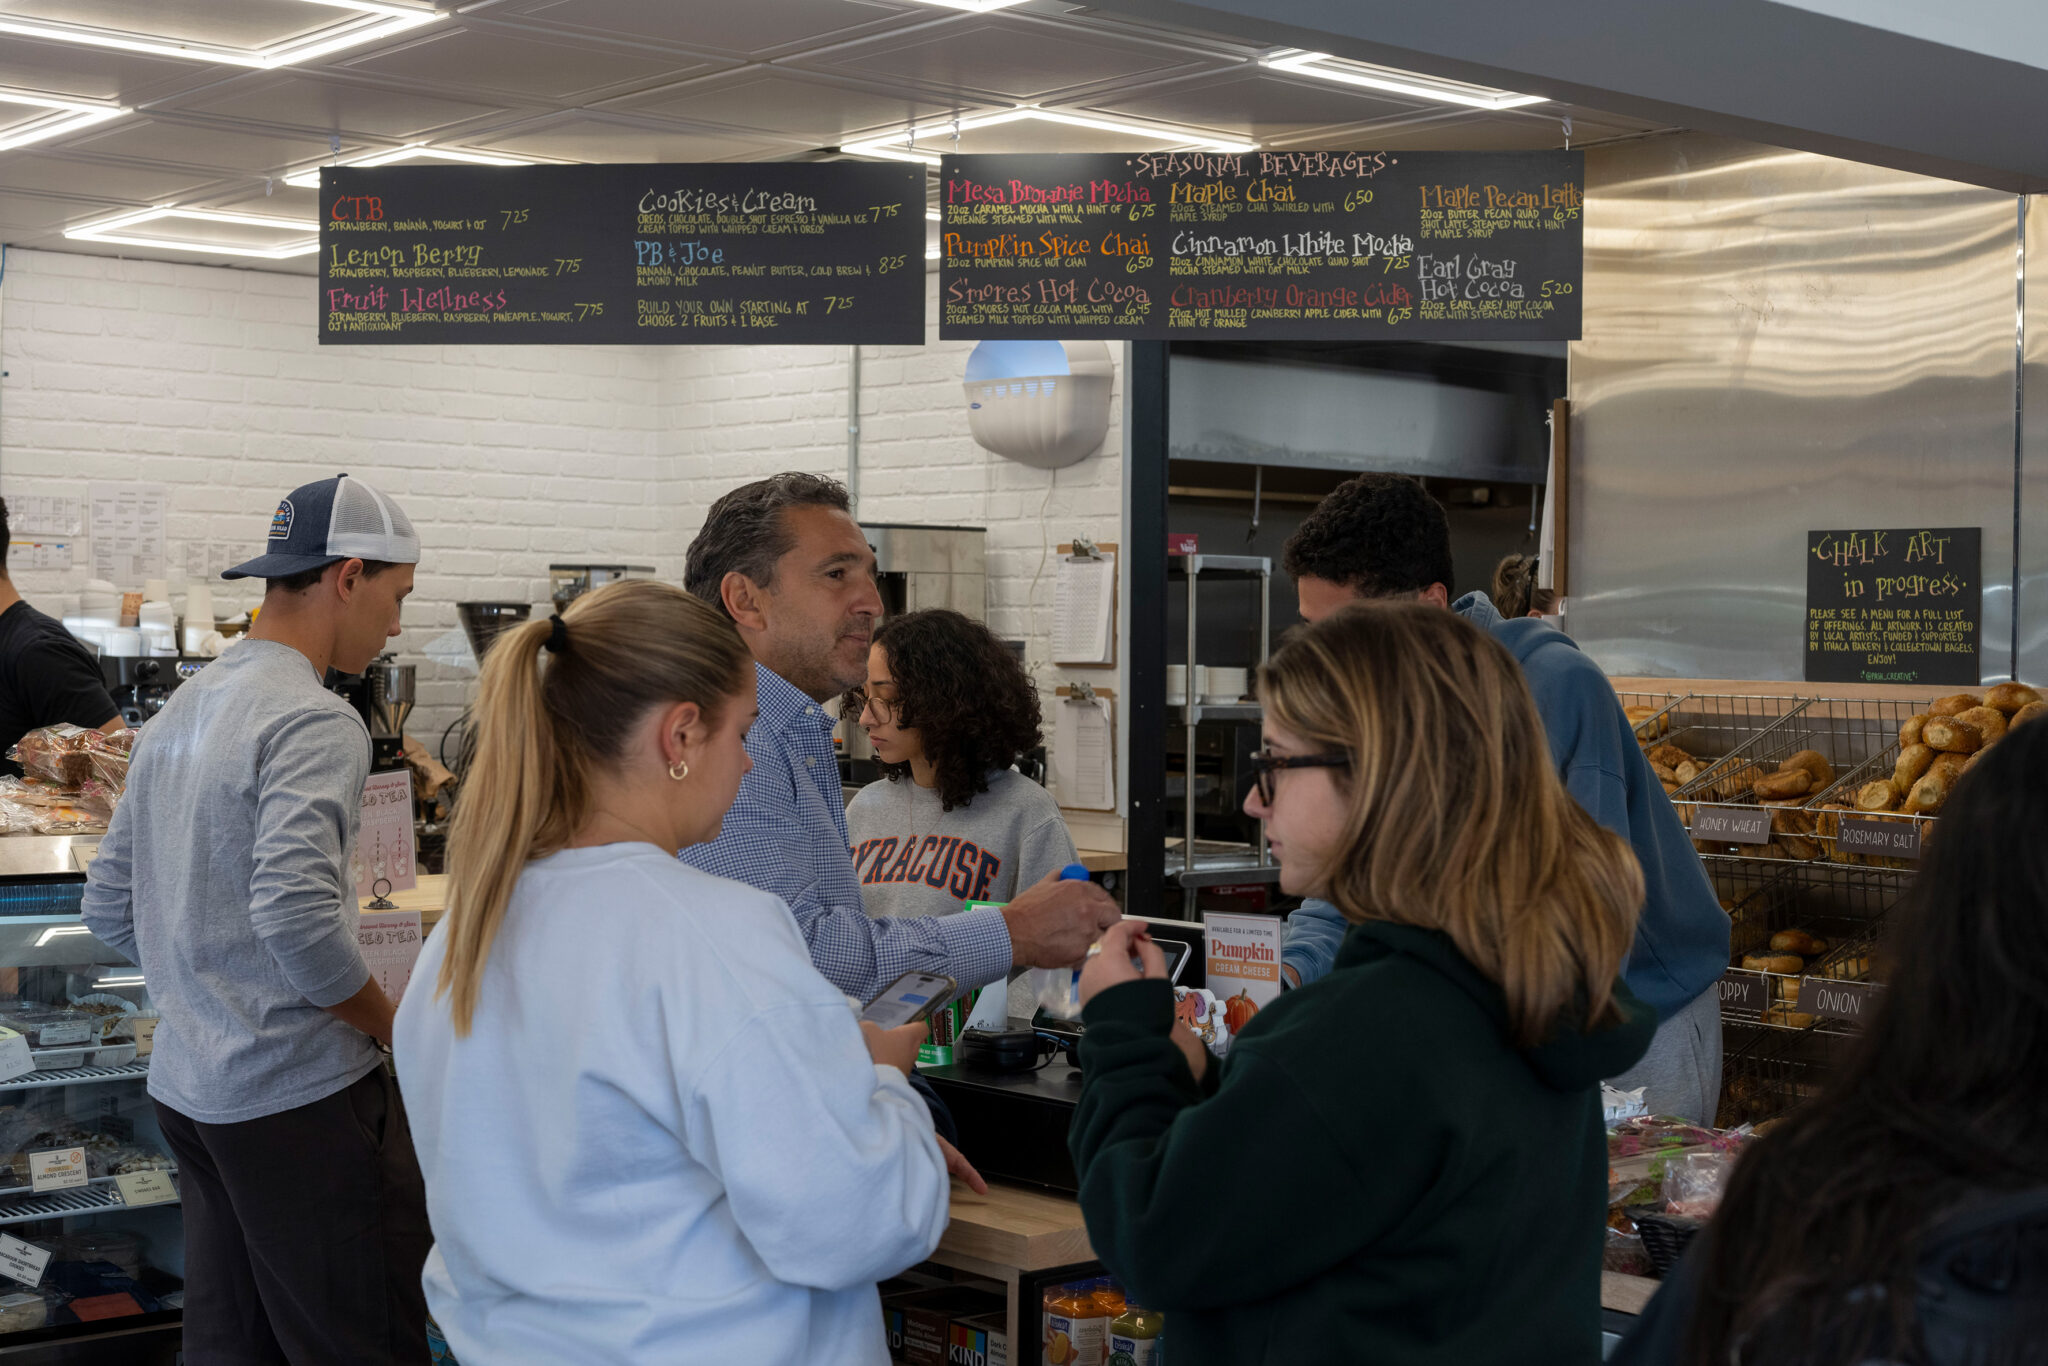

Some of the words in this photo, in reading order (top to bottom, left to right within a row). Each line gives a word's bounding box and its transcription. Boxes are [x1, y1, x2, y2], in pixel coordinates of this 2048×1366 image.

[1135, 152, 1249, 178] SEASONAL
[1260, 151, 1387, 178] BEVERAGES
[638, 189, 729, 214] Cookies
[732, 194, 739, 211] &
[742, 188, 817, 214] Cream
[947, 179, 1006, 204] Mesa
[1009, 179, 1084, 204] Brownie
[1089, 180, 1150, 203] Mocha
[1169, 180, 1237, 205] Maple
[1246, 178, 1296, 202] Chai
[1419, 184, 1480, 209] Maple
[1484, 185, 1539, 209] Pecan
[1542, 182, 1584, 209] Latte
[332, 195, 383, 221] CTB
[1170, 213, 1197, 222] MAPLE
[1202, 213, 1228, 222] SYRUP
[1172, 230, 1277, 256] Cinnamon
[1283, 230, 1345, 257] White
[1352, 232, 1413, 257] Mocha
[1421, 230, 1430, 238] OF
[1435, 230, 1463, 238] MAPLE
[1467, 229, 1493, 238] SYRUP
[634, 240, 663, 265] PB
[668, 243, 677, 263] &
[680, 240, 724, 265] Joe
[944, 233, 1034, 257] Pumpkin
[1039, 230, 1091, 259] Spice
[1101, 231, 1150, 257] Chai
[330, 243, 403, 267] Lemon
[414, 243, 483, 267] Berry
[1417, 253, 1461, 280] Earl
[1466, 253, 1517, 280] Gray
[637, 276, 670, 286] ALMOND
[675, 276, 698, 286] MILK
[947, 278, 1031, 304] S'mores
[1038, 279, 1079, 304] Hot
[1088, 278, 1150, 303] Cocoa
[1421, 280, 1458, 300] Hot
[1465, 280, 1525, 299] Cocoa
[327, 284, 388, 312] Fruit
[400, 287, 507, 312] Wellness
[1171, 282, 1277, 308] Cranberry
[1286, 284, 1358, 309] Orange
[1364, 282, 1413, 307] Cider
[638, 300, 669, 314] BUILD
[676, 300, 702, 314] YOUR
[710, 301, 733, 313] OWN
[740, 301, 791, 314] STARTING
[796, 302, 810, 314] AT
[1420, 310, 1446, 319] MADE
[1446, 310, 1468, 319] WITH
[1471, 310, 1515, 319] STEAMED
[1519, 310, 1544, 319] MILK
[638, 315, 676, 326] CHOOSE
[680, 315, 688, 326] 2
[694, 315, 728, 327] FRUITS
[731, 316, 736, 326] &
[741, 315, 747, 327] 1
[751, 315, 778, 327] BASE
[946, 315, 984, 324] STEAMED
[989, 315, 1009, 324] MILK
[1011, 315, 1045, 324] TOPPED
[1049, 315, 1070, 324] WITH
[1074, 315, 1110, 324] WHIPPED
[1114, 315, 1144, 325] CREAM
[1169, 318, 1176, 327] A
[1178, 318, 1196, 327] HINT
[1200, 319, 1210, 327] OF
[1214, 319, 1247, 328] ORANGE
[1817, 531, 1889, 566] CHALK
[1904, 531, 1951, 564] ART
[1844, 572, 1864, 597] in
[1876, 571, 1959, 601] progress
[1810, 609, 1836, 619] PLEASE
[1841, 609, 1856, 619] SEE
[1861, 609, 1868, 619] A
[1870, 609, 1893, 619] MENU
[1897, 609, 1911, 619] FOR
[1914, 610, 1920, 619] A
[1923, 609, 1942, 619] FULL
[1945, 610, 1964, 619] LIST
[1810, 621, 1819, 630] OF
[1871, 621, 1883, 630] ALL
[1887, 622, 1920, 630] ARTWORK
[1925, 622, 1932, 630] IS
[1938, 621, 1973, 632] CREATED
[1810, 632, 1818, 640] BY
[1824, 632, 1845, 640] LOCAL
[1883, 632, 1912, 641] FUNDED
[1915, 631, 1918, 640] &
[1921, 632, 1963, 641] SUPPORTED
[1810, 642, 1818, 651] BY
[1824, 642, 1849, 651] ITHACA
[1852, 642, 1881, 652] BAKERY
[1884, 642, 1888, 651] &
[1890, 643, 1941, 652] COLLEGETOWN
[1868, 654, 1896, 664] ENJOY!
[379, 789, 407, 804] TEA
[1700, 817, 1727, 831] HONEY
[1732, 819, 1762, 834] WHEAT
[1843, 829, 1889, 846] ROSEMARY
[1893, 834, 1915, 849] SALT
[358, 932, 384, 945] CED
[387, 930, 417, 944] TEA
[1211, 939, 1274, 962] Pumpkin
[1216, 963, 1239, 974] CREAM
[1243, 966, 1270, 977] CHEESE
[1817, 989, 1861, 1014] ONION
